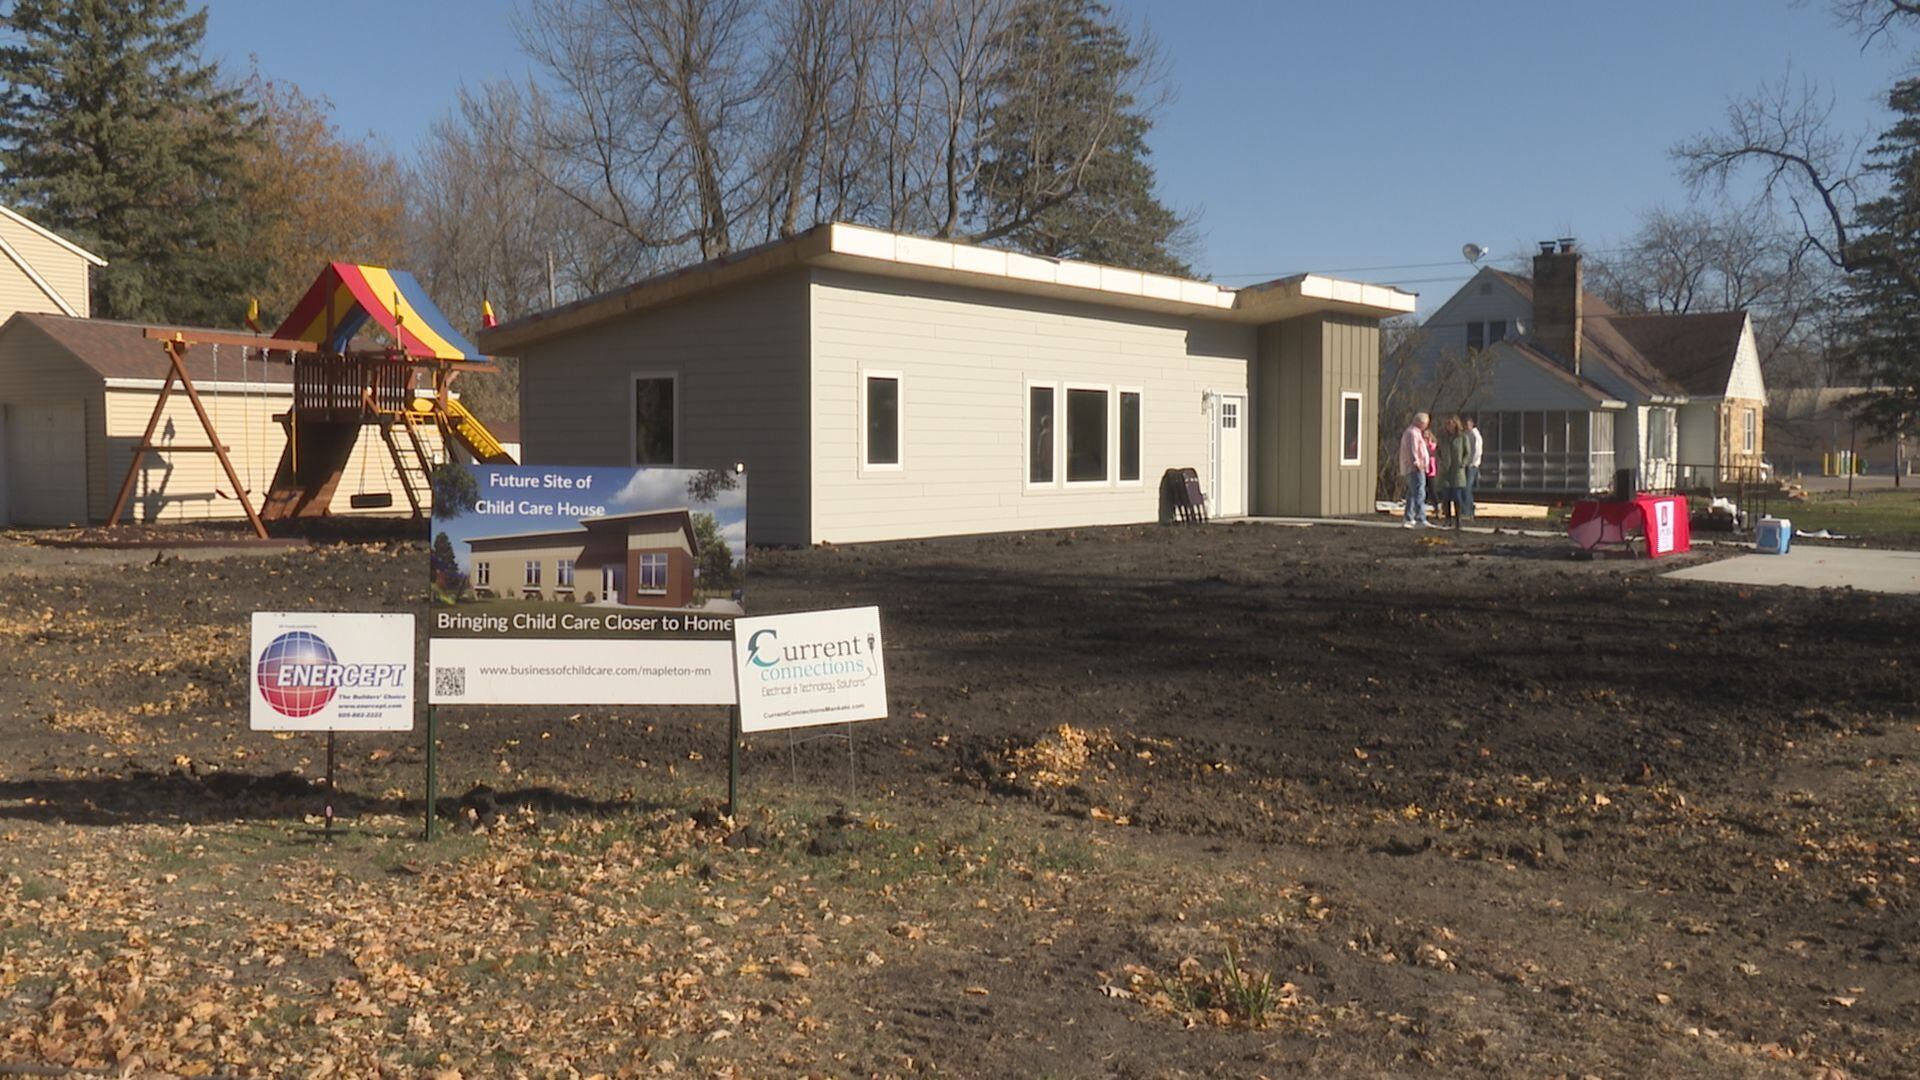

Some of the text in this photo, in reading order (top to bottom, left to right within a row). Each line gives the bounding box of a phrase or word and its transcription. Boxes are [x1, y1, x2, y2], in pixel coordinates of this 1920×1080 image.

[490, 472, 592, 489] Future Site of
[475, 500, 606, 517] Child Care House
[437, 612, 733, 633] Bringing Child Care Closer to Home
[746, 629, 862, 667] Current
[277, 664, 406, 687] ENERCEPT
[479, 664, 712, 677] www.businessofchildcare.com/mapleton-mn
[761, 658, 864, 681] connections
